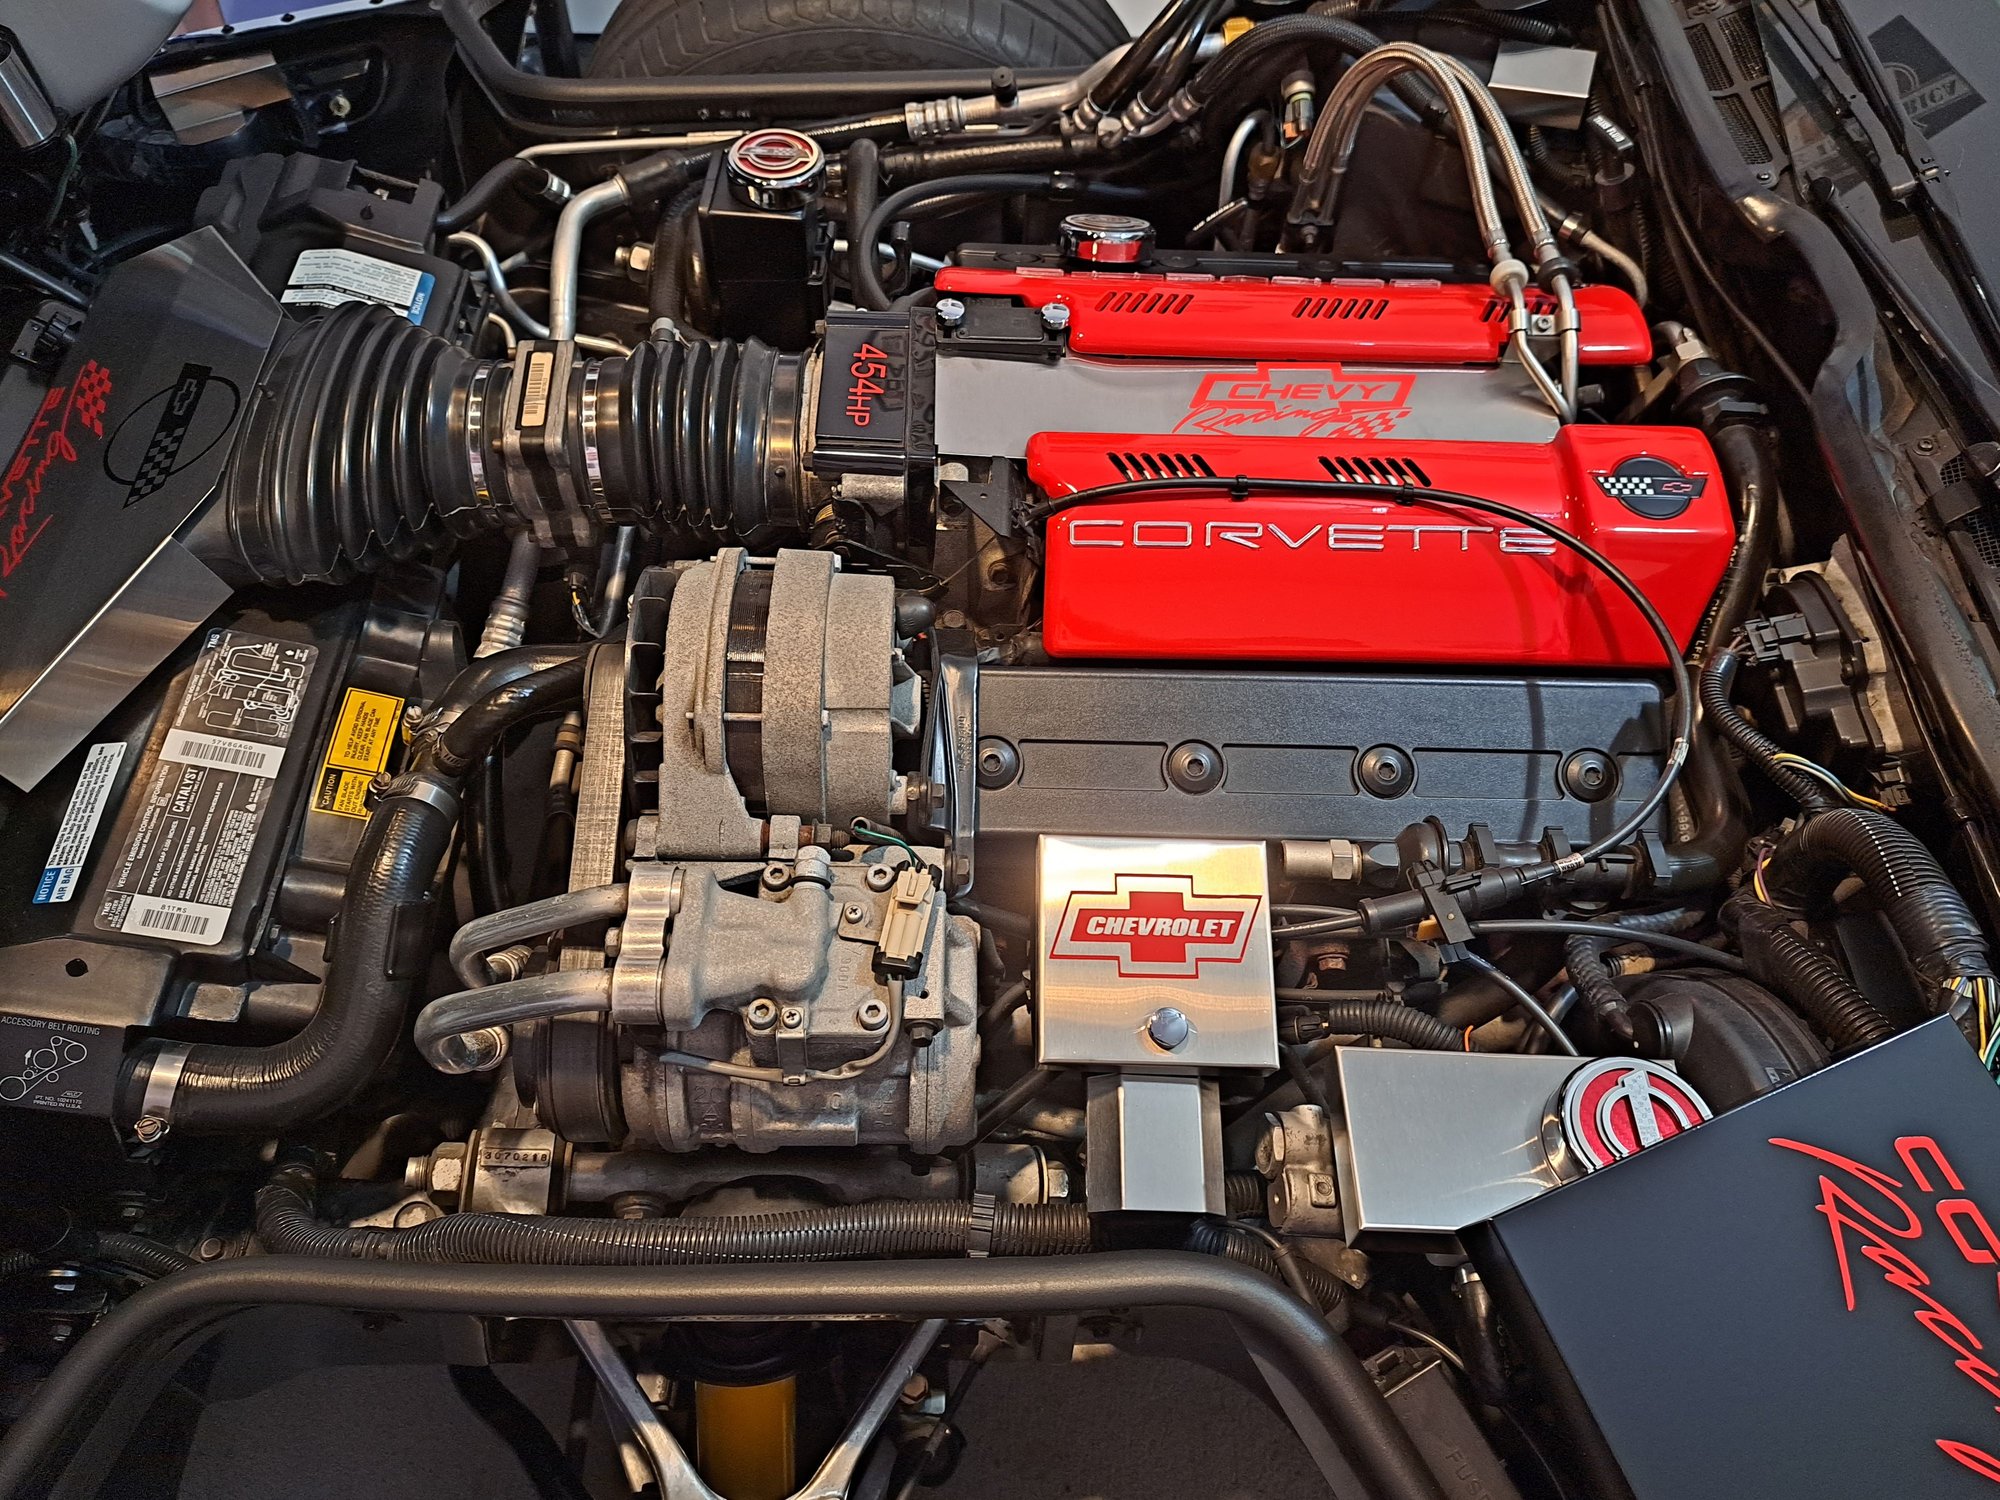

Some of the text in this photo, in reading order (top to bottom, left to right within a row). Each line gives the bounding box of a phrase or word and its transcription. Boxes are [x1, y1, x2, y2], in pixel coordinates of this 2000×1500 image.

[410, 291, 424, 314] NOTICE
[846, 343, 888, 427] 454HP
[1227, 383, 1386, 400] CHEVY
[1171, 403, 1349, 438] Racing
[0, 386, 65, 514] VETTE
[1068, 519, 1557, 556] CORVETTE
[207, 633, 220, 648] TMS
[171, 767, 198, 812] CATALYST
[321, 773, 337, 805] CAUTION
[116, 861, 133, 888] VEHICLE
[127, 832, 144, 861] EMISSION
[138, 803, 155, 831] CONTROL
[149, 764, 170, 803] INFORMATION
[37, 870, 56, 900] NOTICE
[55, 868, 74, 899] AIR BAG
[101, 902, 112, 916] TMS
[1086, 916, 1236, 938] CHEVROLET
[1, 1017, 100, 1035] ACCESSORY BELT ROUTING
